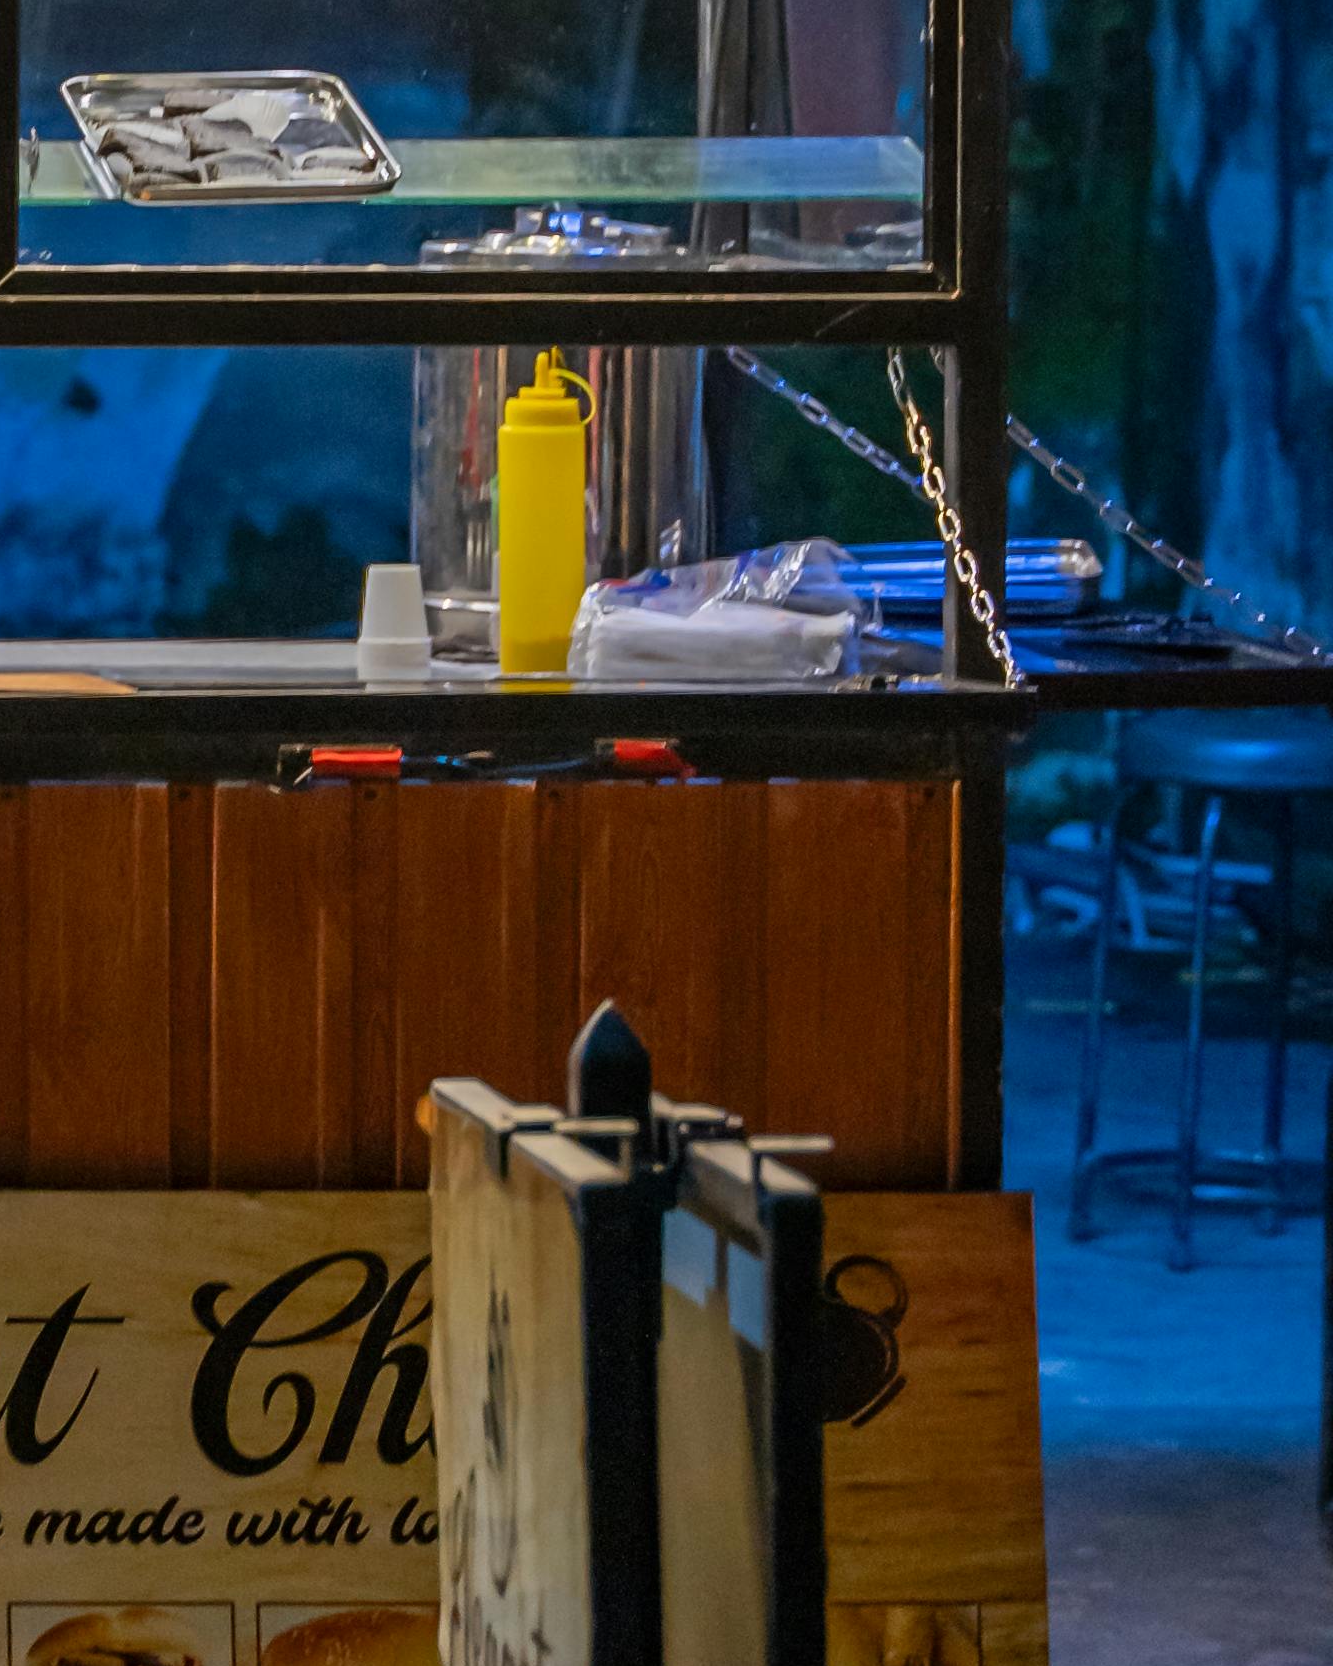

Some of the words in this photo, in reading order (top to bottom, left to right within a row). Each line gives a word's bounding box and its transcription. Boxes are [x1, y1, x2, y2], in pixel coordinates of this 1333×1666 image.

[191, 1249, 439, 1477] Ch
[22, 1493, 206, 1546] made
[225, 1492, 371, 1548] with
[387, 1496, 439, 1545] lo
